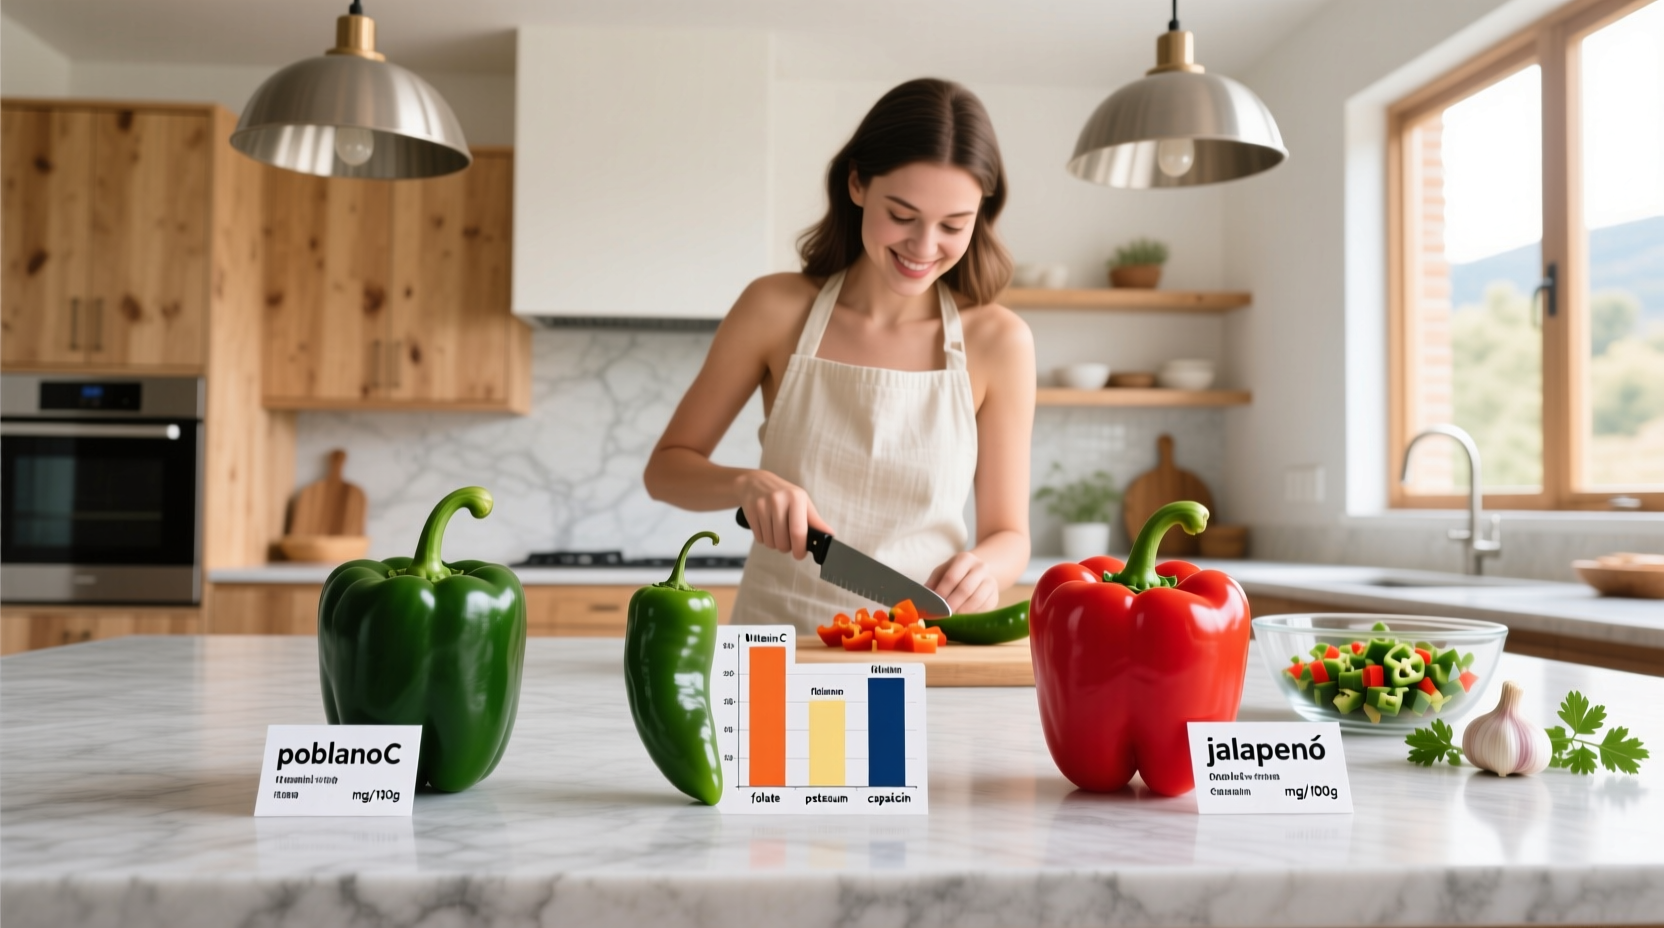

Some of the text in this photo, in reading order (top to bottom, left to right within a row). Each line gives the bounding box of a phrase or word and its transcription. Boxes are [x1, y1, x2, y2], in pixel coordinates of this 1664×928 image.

[779, 633, 787, 643] C
[276, 741, 402, 771] poblanoC
[1206, 734, 1326, 767] jalapenó
[750, 791, 781, 804] folate
[1284, 783, 1338, 800] mg/100g
